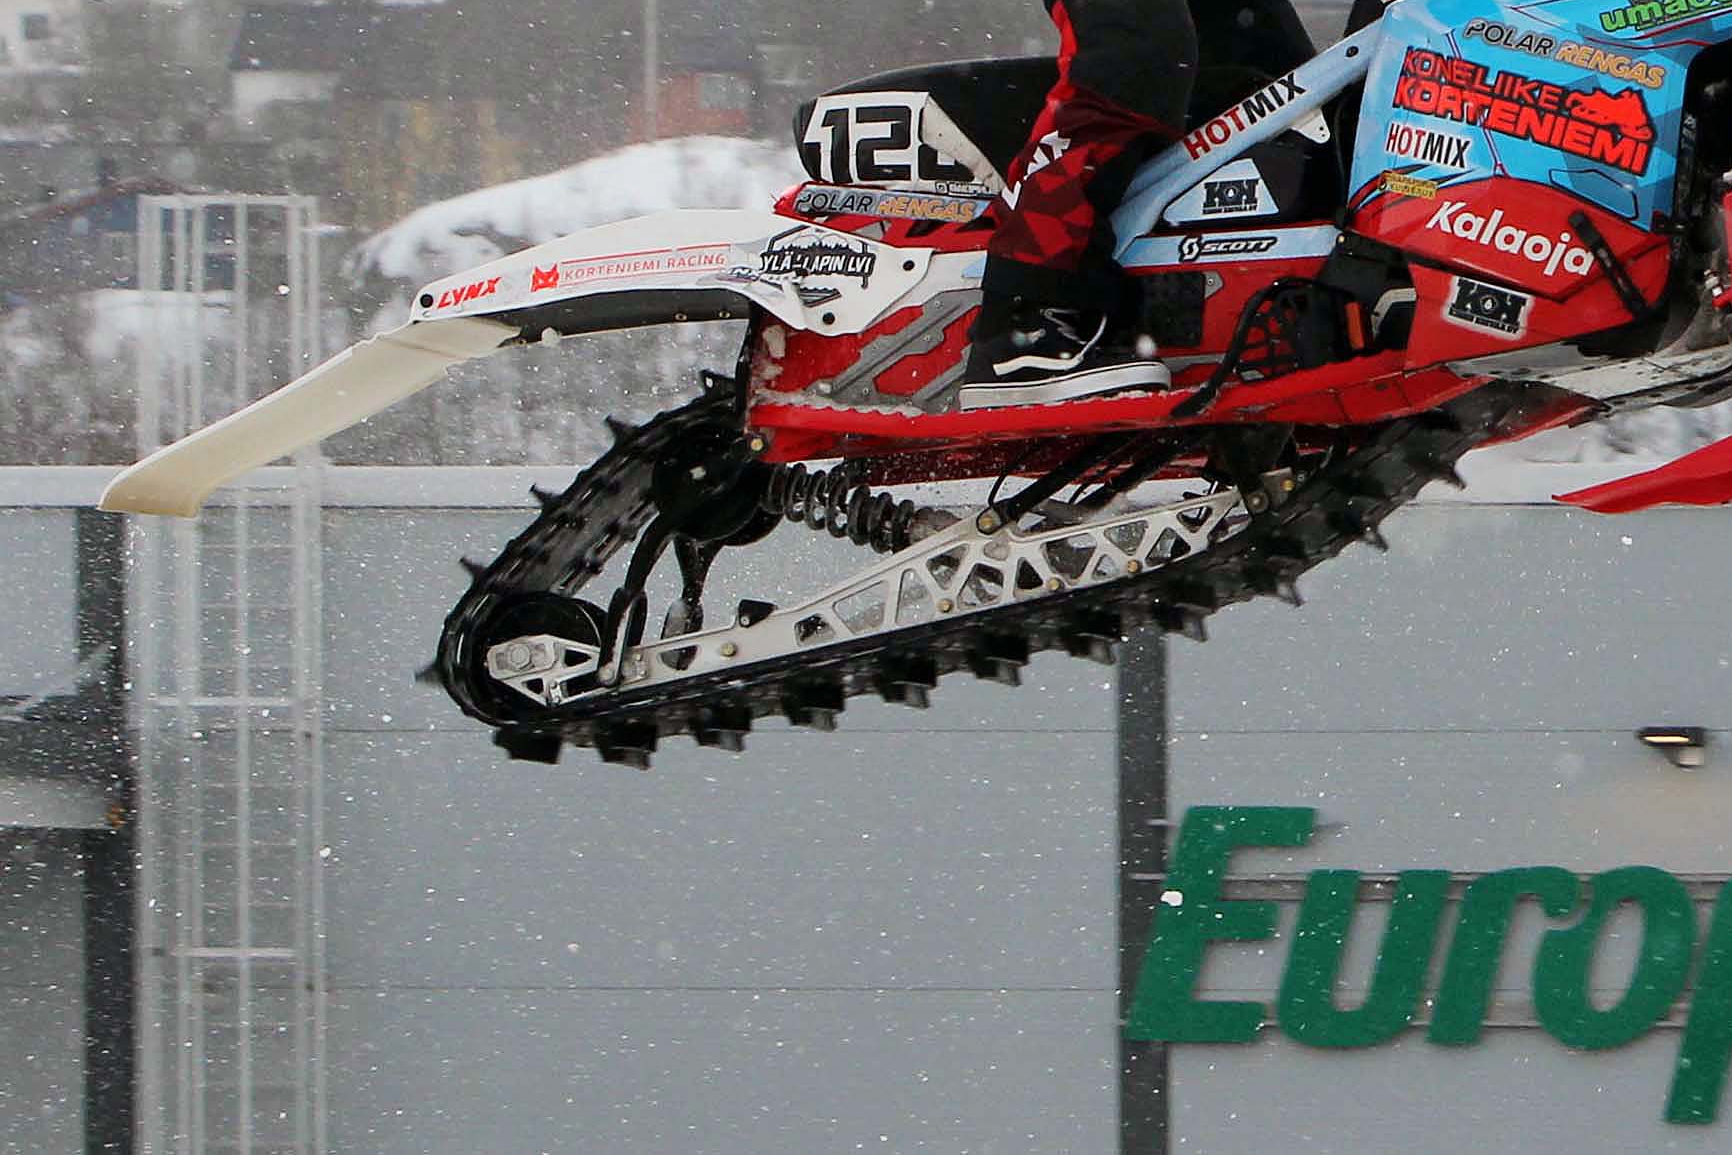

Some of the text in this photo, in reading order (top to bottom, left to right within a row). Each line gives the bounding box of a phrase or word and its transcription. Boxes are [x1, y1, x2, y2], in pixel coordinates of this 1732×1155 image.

[1465, 22, 1666, 89] POLAR RENGAS
[1403, 48, 1562, 110] KONELIIKE
[1183, 72, 1307, 161] HOTMIX
[1394, 75, 1650, 174] KORTENIEMI
[1385, 123, 1471, 169] HOTMIX
[795, 192, 873, 215] POLAR
[1202, 236, 1276, 255] SCOTT
[1425, 200, 1596, 277] Kalaoja
[564, 252, 726, 282] KORTENIEMI RACING
[847, 255, 874, 274] LVI
[436, 276, 502, 309] LYNX
